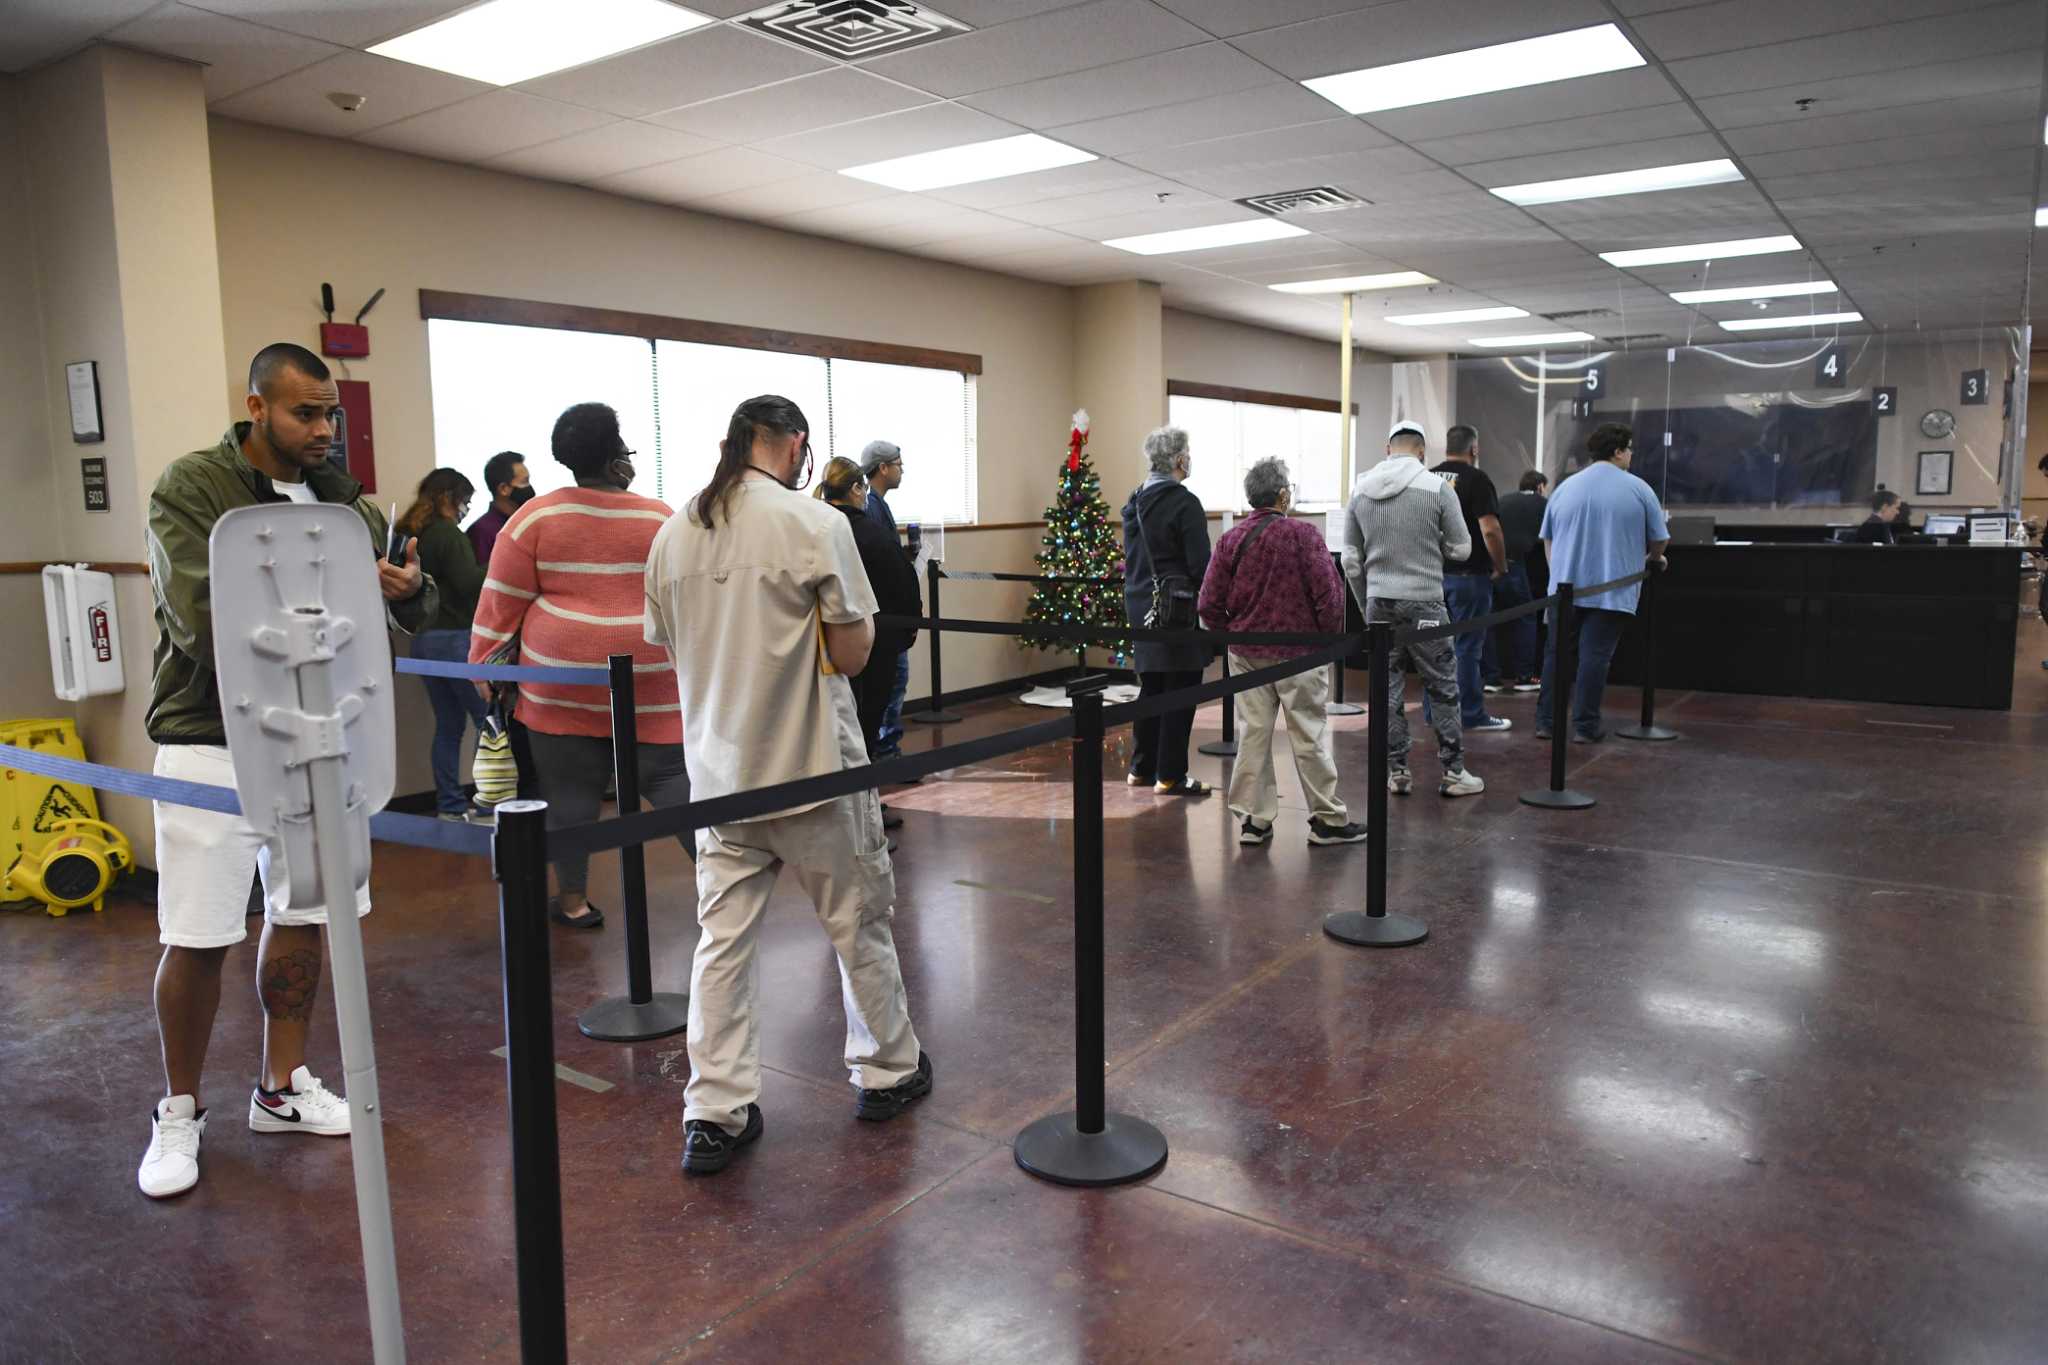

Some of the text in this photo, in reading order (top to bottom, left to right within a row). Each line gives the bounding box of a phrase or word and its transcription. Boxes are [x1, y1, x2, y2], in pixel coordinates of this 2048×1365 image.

[1823, 354, 1838, 377] 4
[1587, 369, 1598, 390] 5
[1967, 378, 1978, 397] 3
[1877, 393, 1889, 410] 2
[95, 616, 109, 659] FIRE
